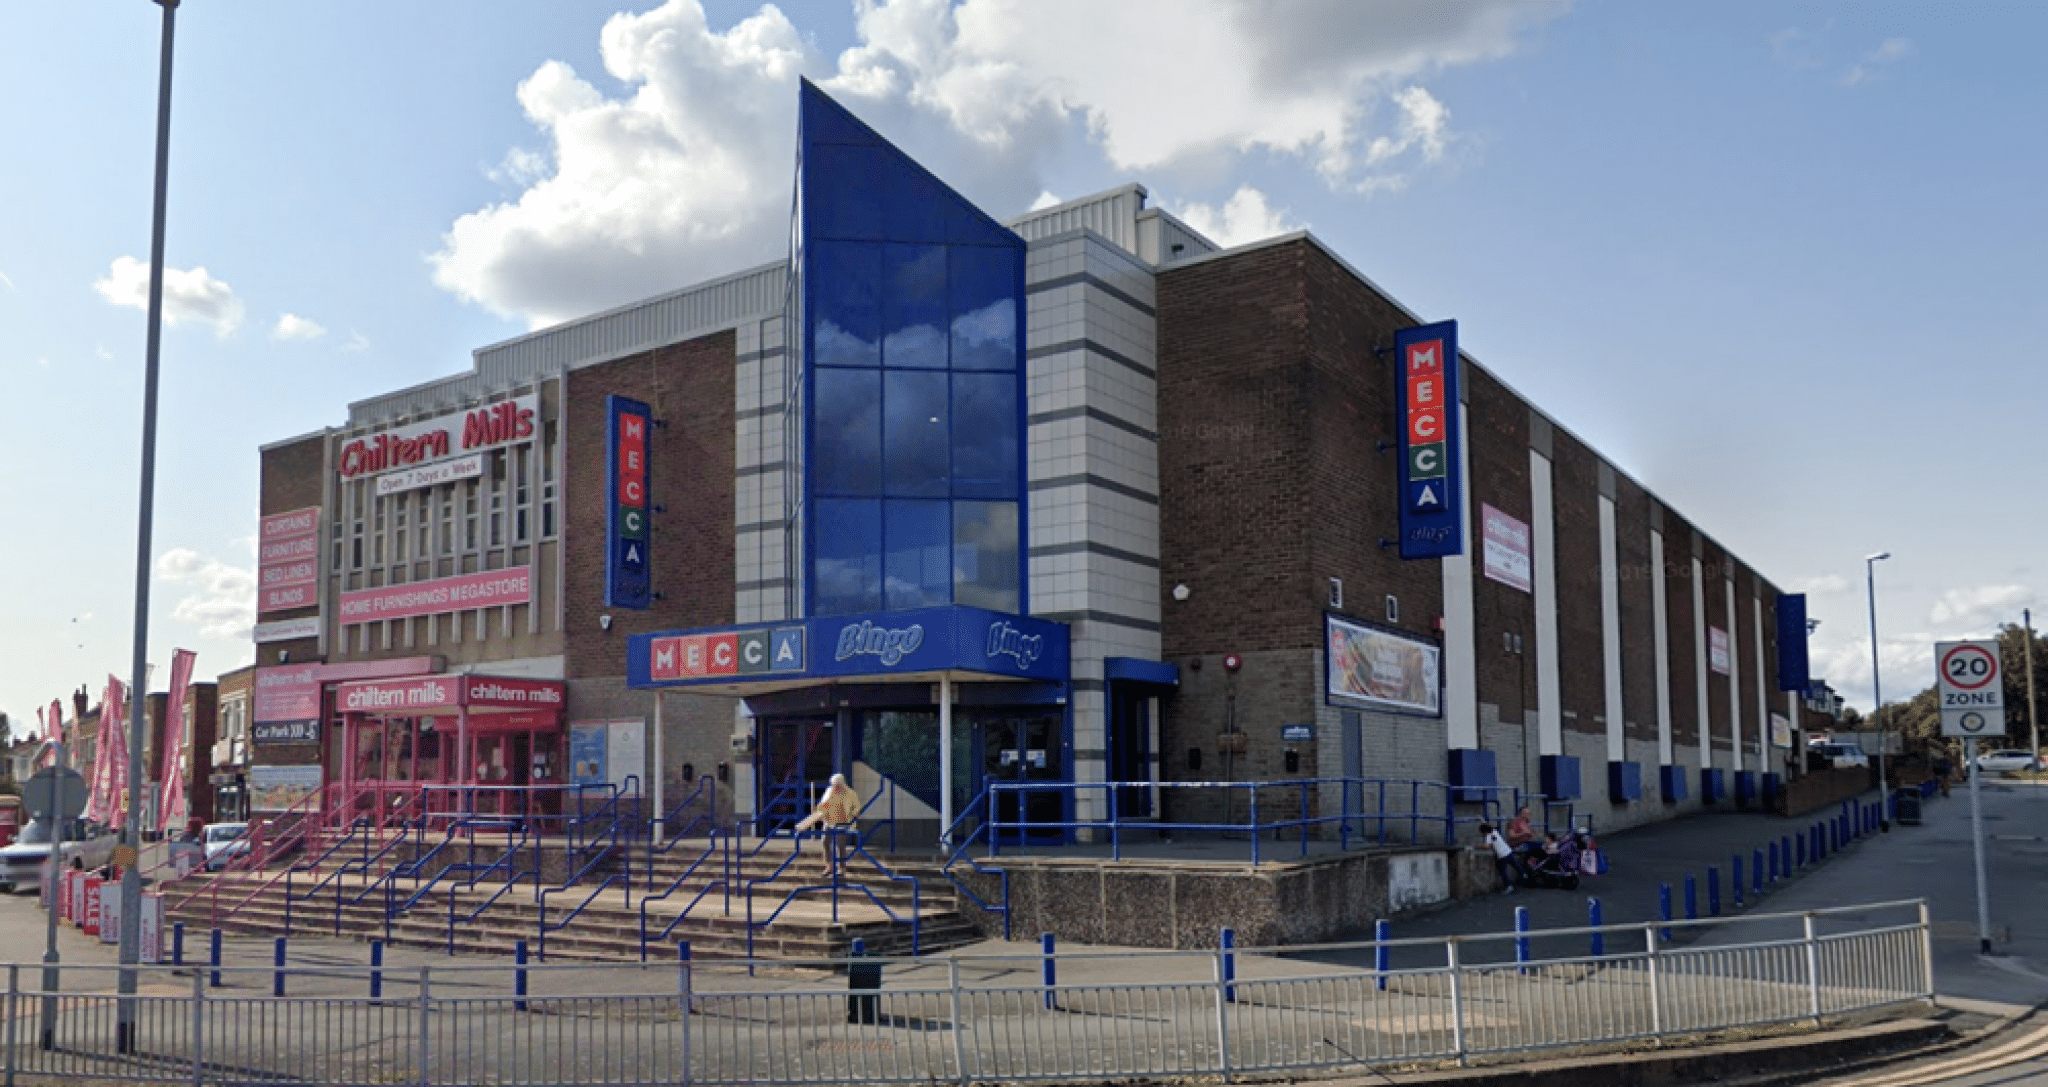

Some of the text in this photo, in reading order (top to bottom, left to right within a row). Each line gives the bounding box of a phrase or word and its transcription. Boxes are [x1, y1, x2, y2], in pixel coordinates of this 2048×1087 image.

[340, 402, 533, 476] Chiltern Mills
[1412, 347, 1439, 507] MECCA
[380, 475, 404, 491] Open
[406, 473, 414, 483] 7
[416, 468, 440, 485] Days
[452, 461, 477, 474] Week
[626, 416, 643, 564] MECCA
[265, 513, 310, 535] CURTAINS
[261, 537, 315, 558] FURNITURE
[263, 562, 312, 582] BED LINEN
[269, 587, 304, 605] BLINDS
[343, 578, 528, 615] HOME FURNISHINGS MEGASTORE
[656, 619, 926, 669] MECCA Bingo
[986, 620, 1043, 670] Bingo
[1950, 657, 1989, 677] 20
[347, 681, 445, 709] chiltern mills
[470, 682, 561, 703] chiltern mills
[1945, 692, 1997, 705] ZONE
[255, 724, 289, 738] Car Park
